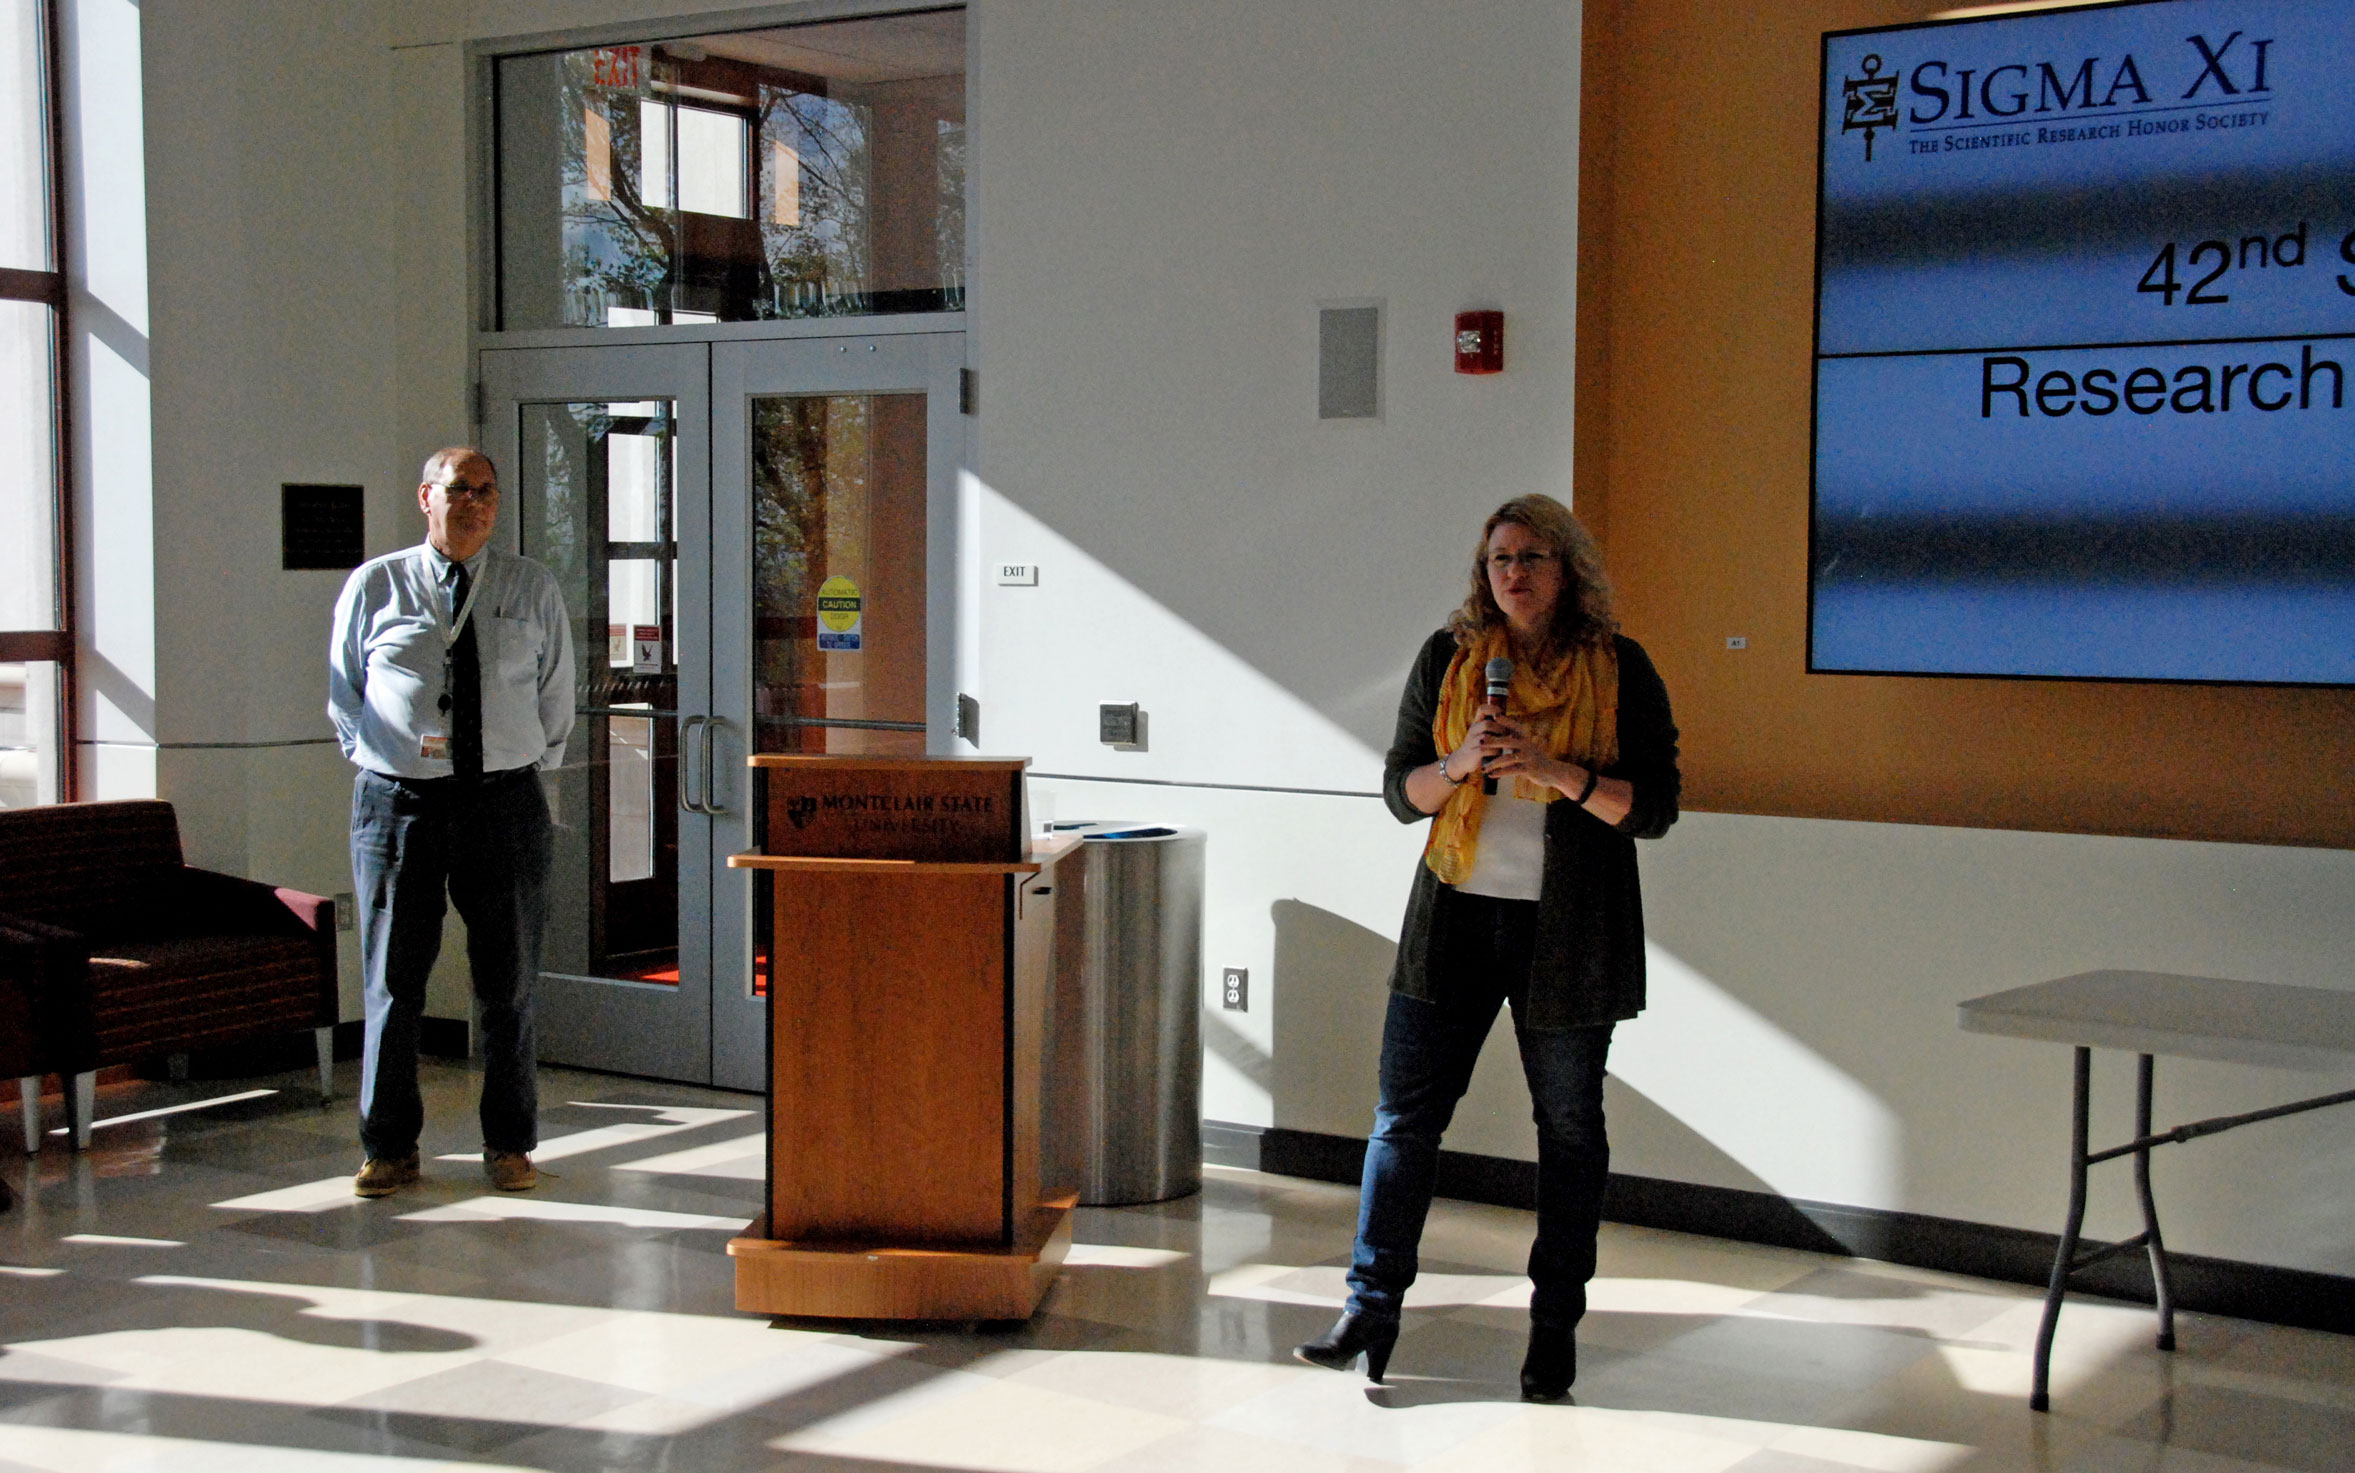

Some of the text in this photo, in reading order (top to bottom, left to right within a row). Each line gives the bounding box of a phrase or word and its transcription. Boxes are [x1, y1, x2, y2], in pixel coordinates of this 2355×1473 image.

[594, 46, 640, 88] EXIT
[2181, 31, 2274, 99] XI
[1910, 111, 2269, 154] THE SCIENTIFIC RESEARCH HONOR SOCIETY
[2137, 222, 2306, 306] 42nd
[1981, 345, 2343, 418] Research
[1003, 565, 1026, 577] EXIT
[823, 600, 857, 609] CAUTION
[822, 794, 995, 813] MONTCLAIR STATE
